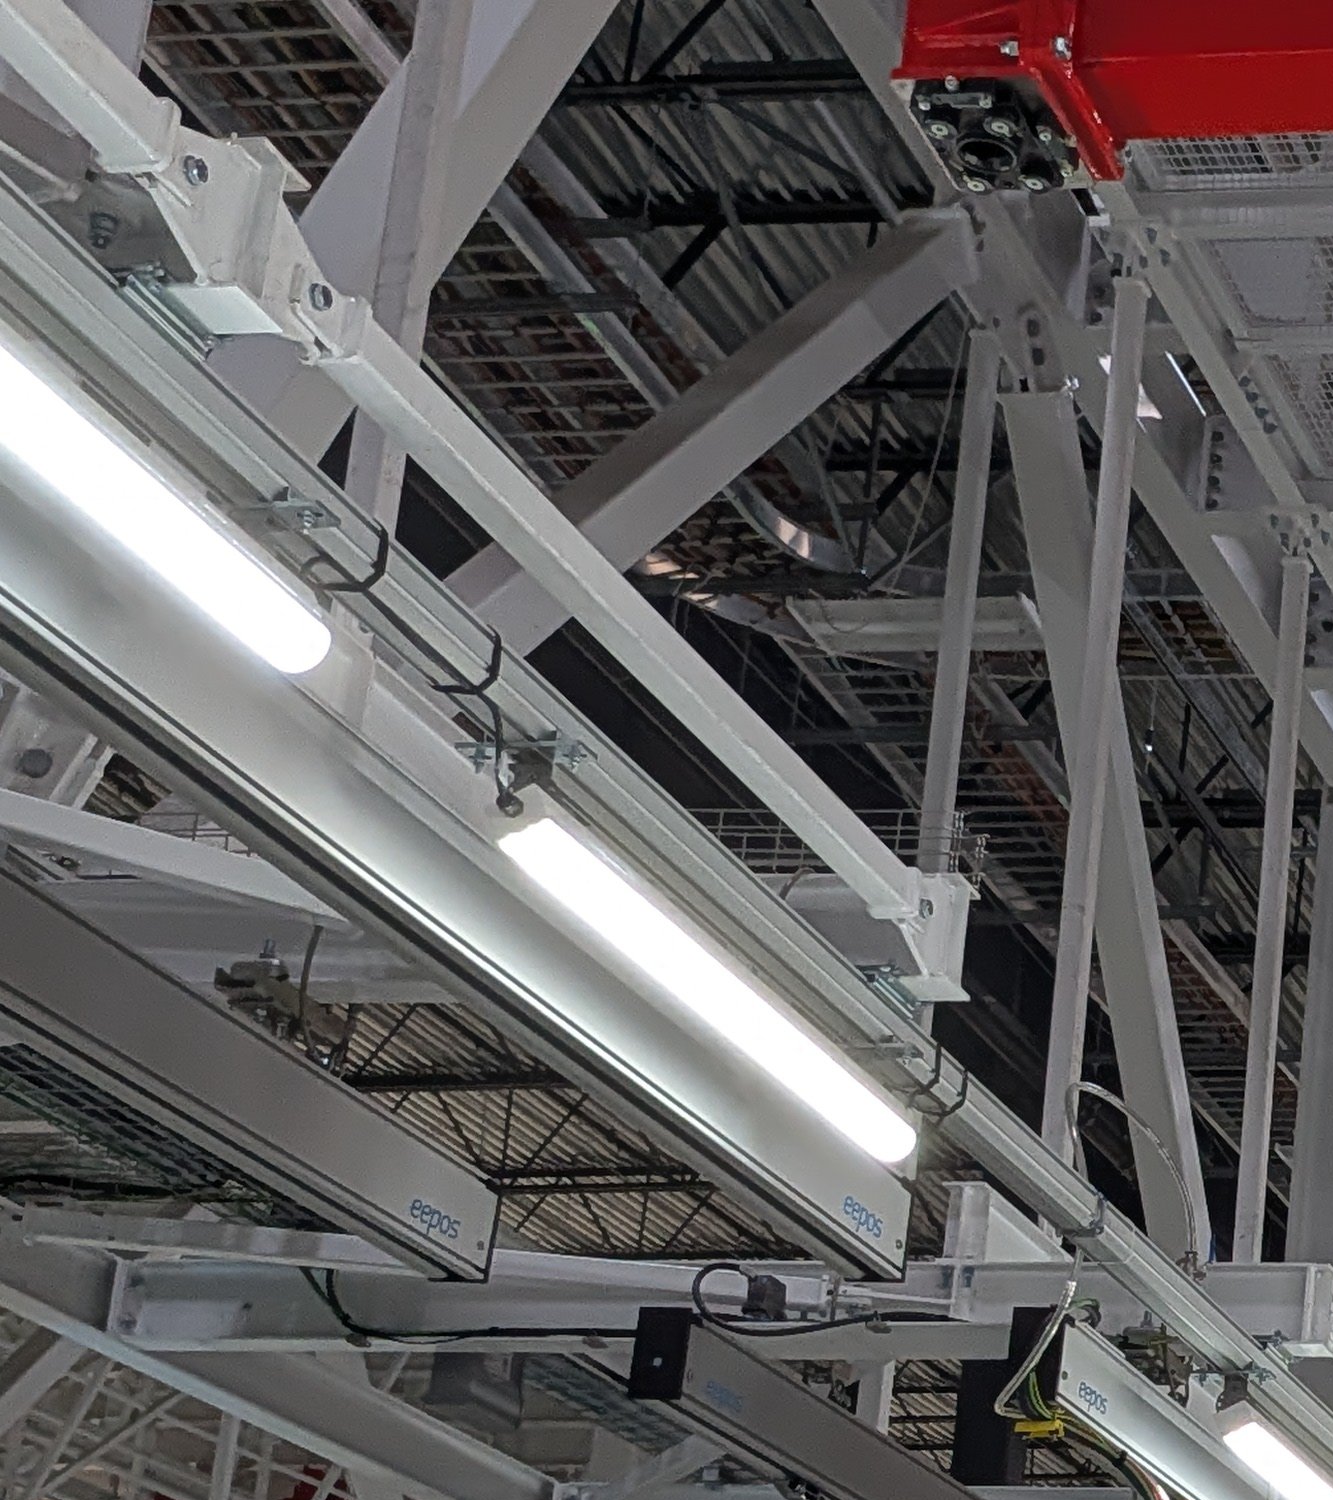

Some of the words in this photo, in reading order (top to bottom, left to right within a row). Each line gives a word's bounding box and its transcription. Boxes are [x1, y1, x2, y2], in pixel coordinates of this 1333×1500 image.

[410, 1199, 461, 1239] eepos
[843, 1195, 883, 1238] eepos
[1078, 1381, 1108, 1414] eepos
